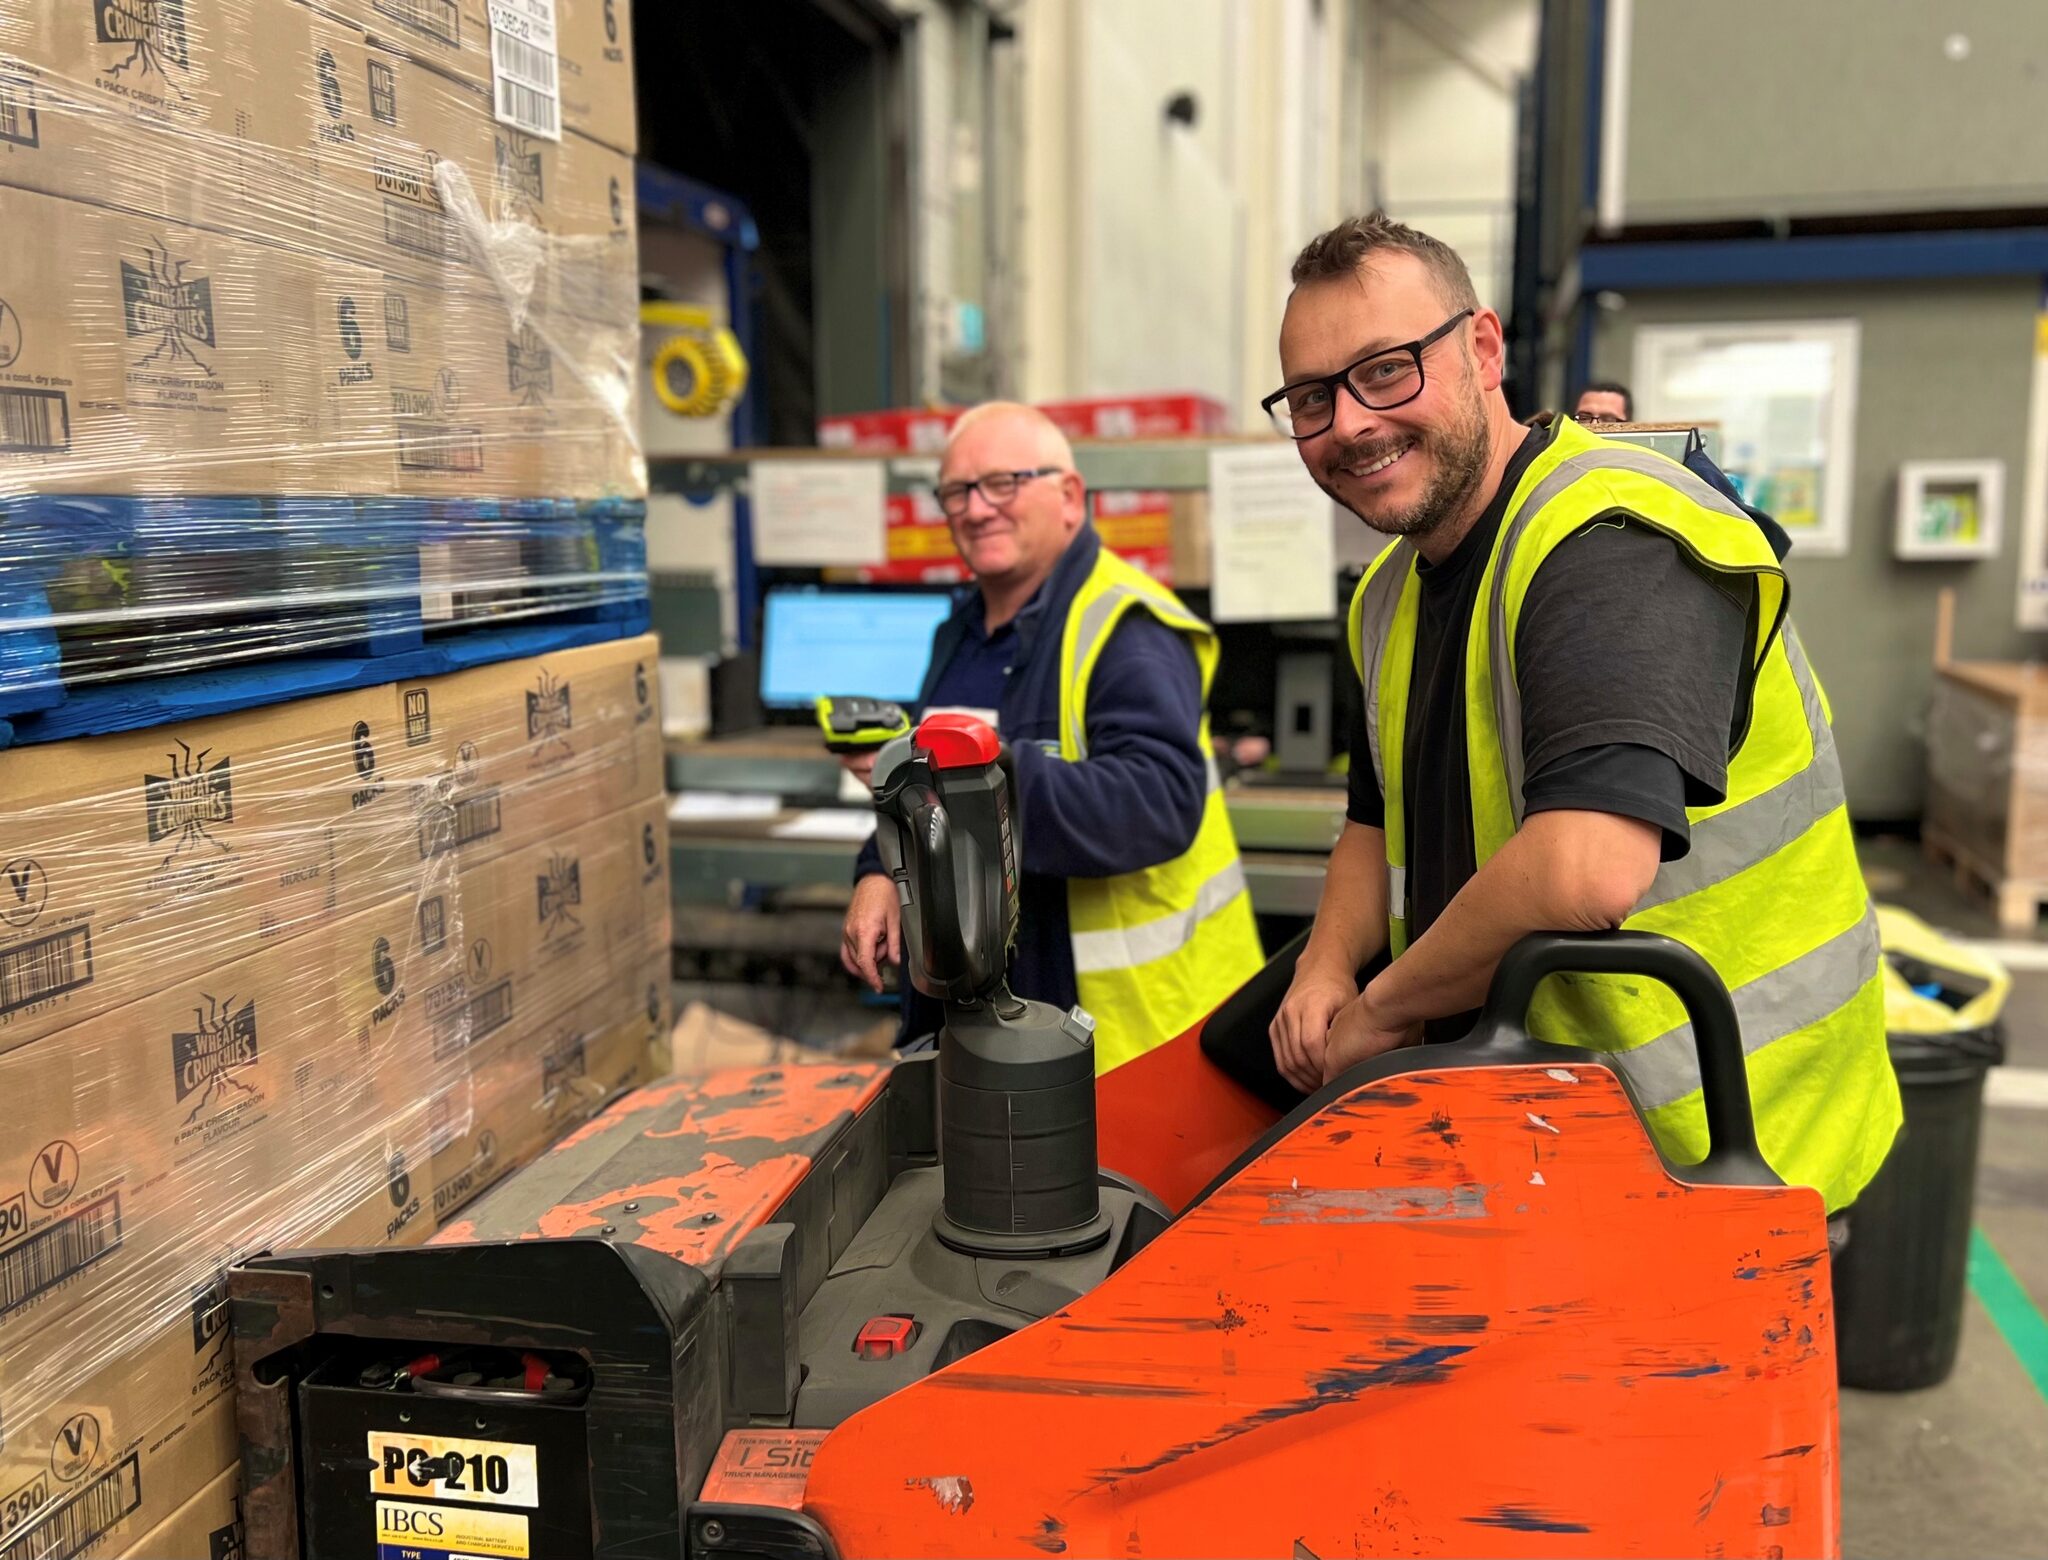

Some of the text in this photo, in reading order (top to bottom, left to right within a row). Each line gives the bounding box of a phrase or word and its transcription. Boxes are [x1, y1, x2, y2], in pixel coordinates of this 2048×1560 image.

[316, 47, 342, 119] 6
[338, 296, 363, 360] 6
[407, 693, 426, 717] NO
[409, 718, 427, 737] VAT
[352, 720, 375, 781] 6
[372, 936, 395, 996] 6
[195, 1020, 236, 1057] WHEAT
[183, 1034, 253, 1090] CRUNCHIES
[42, 1144, 64, 1184] V
[386, 1151, 410, 1208] 6
[30, 1215, 52, 1231] Store
[387, 1197, 421, 1241] PACKS
[191, 1386, 197, 1396] 6
[198, 1370, 222, 1392] PACK
[63, 1418, 84, 1457] V
[124, 1435, 144, 1455] place
[738, 1437, 756, 1446] This
[724, 1471, 750, 1479] TRUCK
[381, 1507, 444, 1537] IBCS
[401, 1550, 422, 1560] TYPE
[485, 1537, 508, 1545] BATTERY
